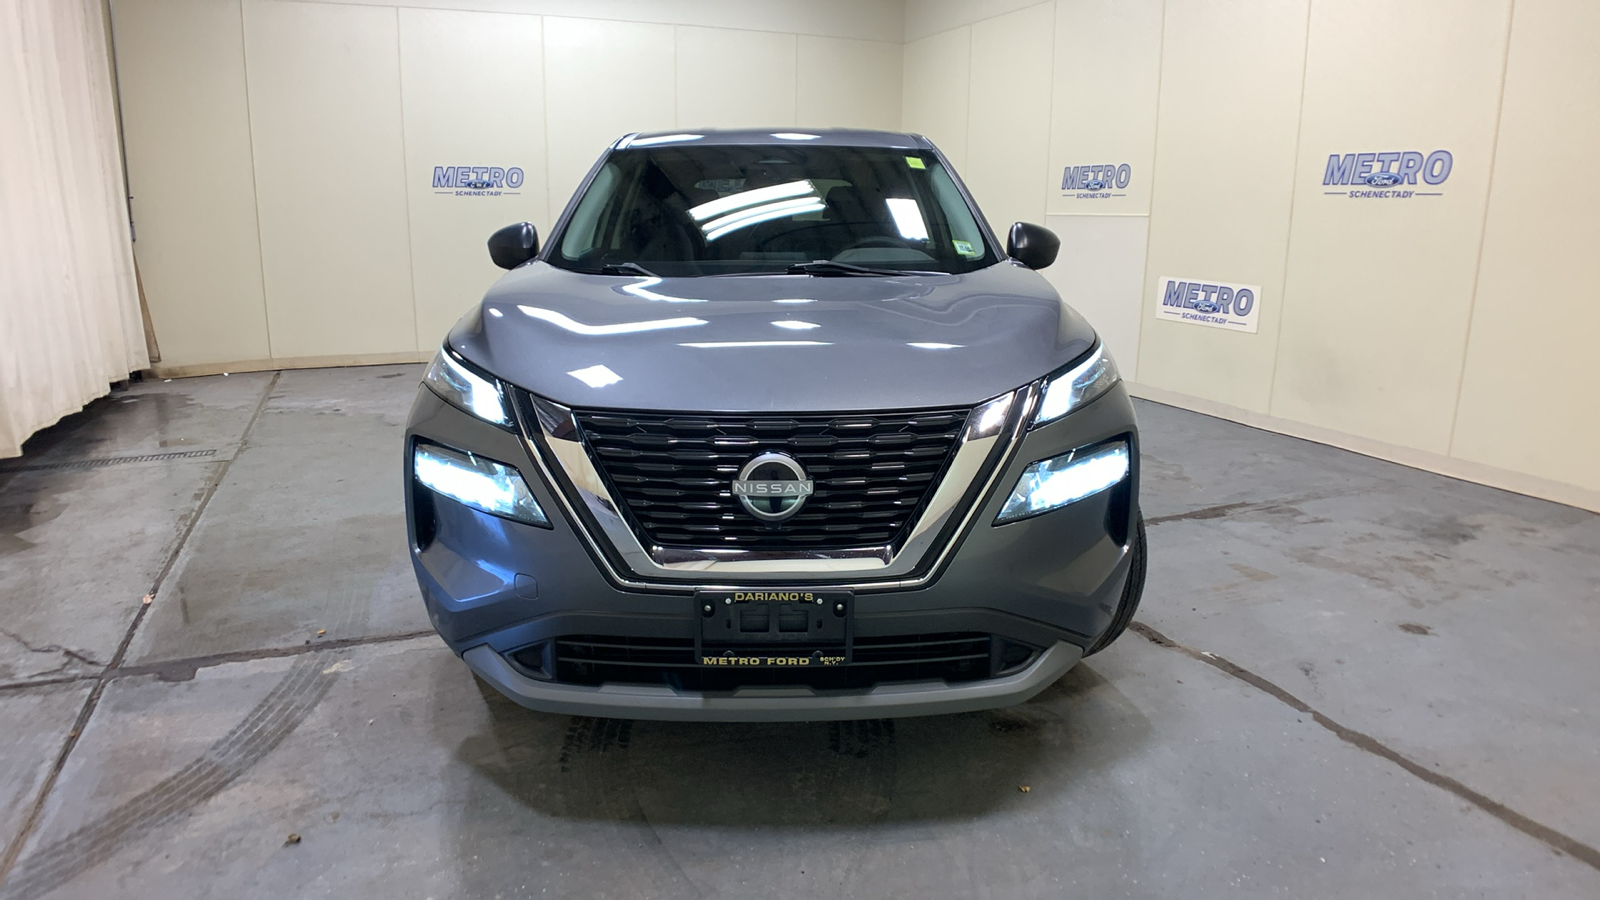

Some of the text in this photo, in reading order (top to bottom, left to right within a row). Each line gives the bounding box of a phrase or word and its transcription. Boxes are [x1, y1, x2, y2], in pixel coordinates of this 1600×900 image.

[1323, 150, 1453, 185] METRO
[432, 166, 524, 188] METRO
[1061, 163, 1131, 190] METRO
[1349, 190, 1415, 198] SCHENECTADY
[1163, 280, 1254, 317] METRO
[1181, 312, 1228, 324] SCHENECTADY
[734, 482, 811, 493] NISSAN
[734, 592, 814, 601] DARIANO'S
[703, 657, 810, 665] METRO FORD
